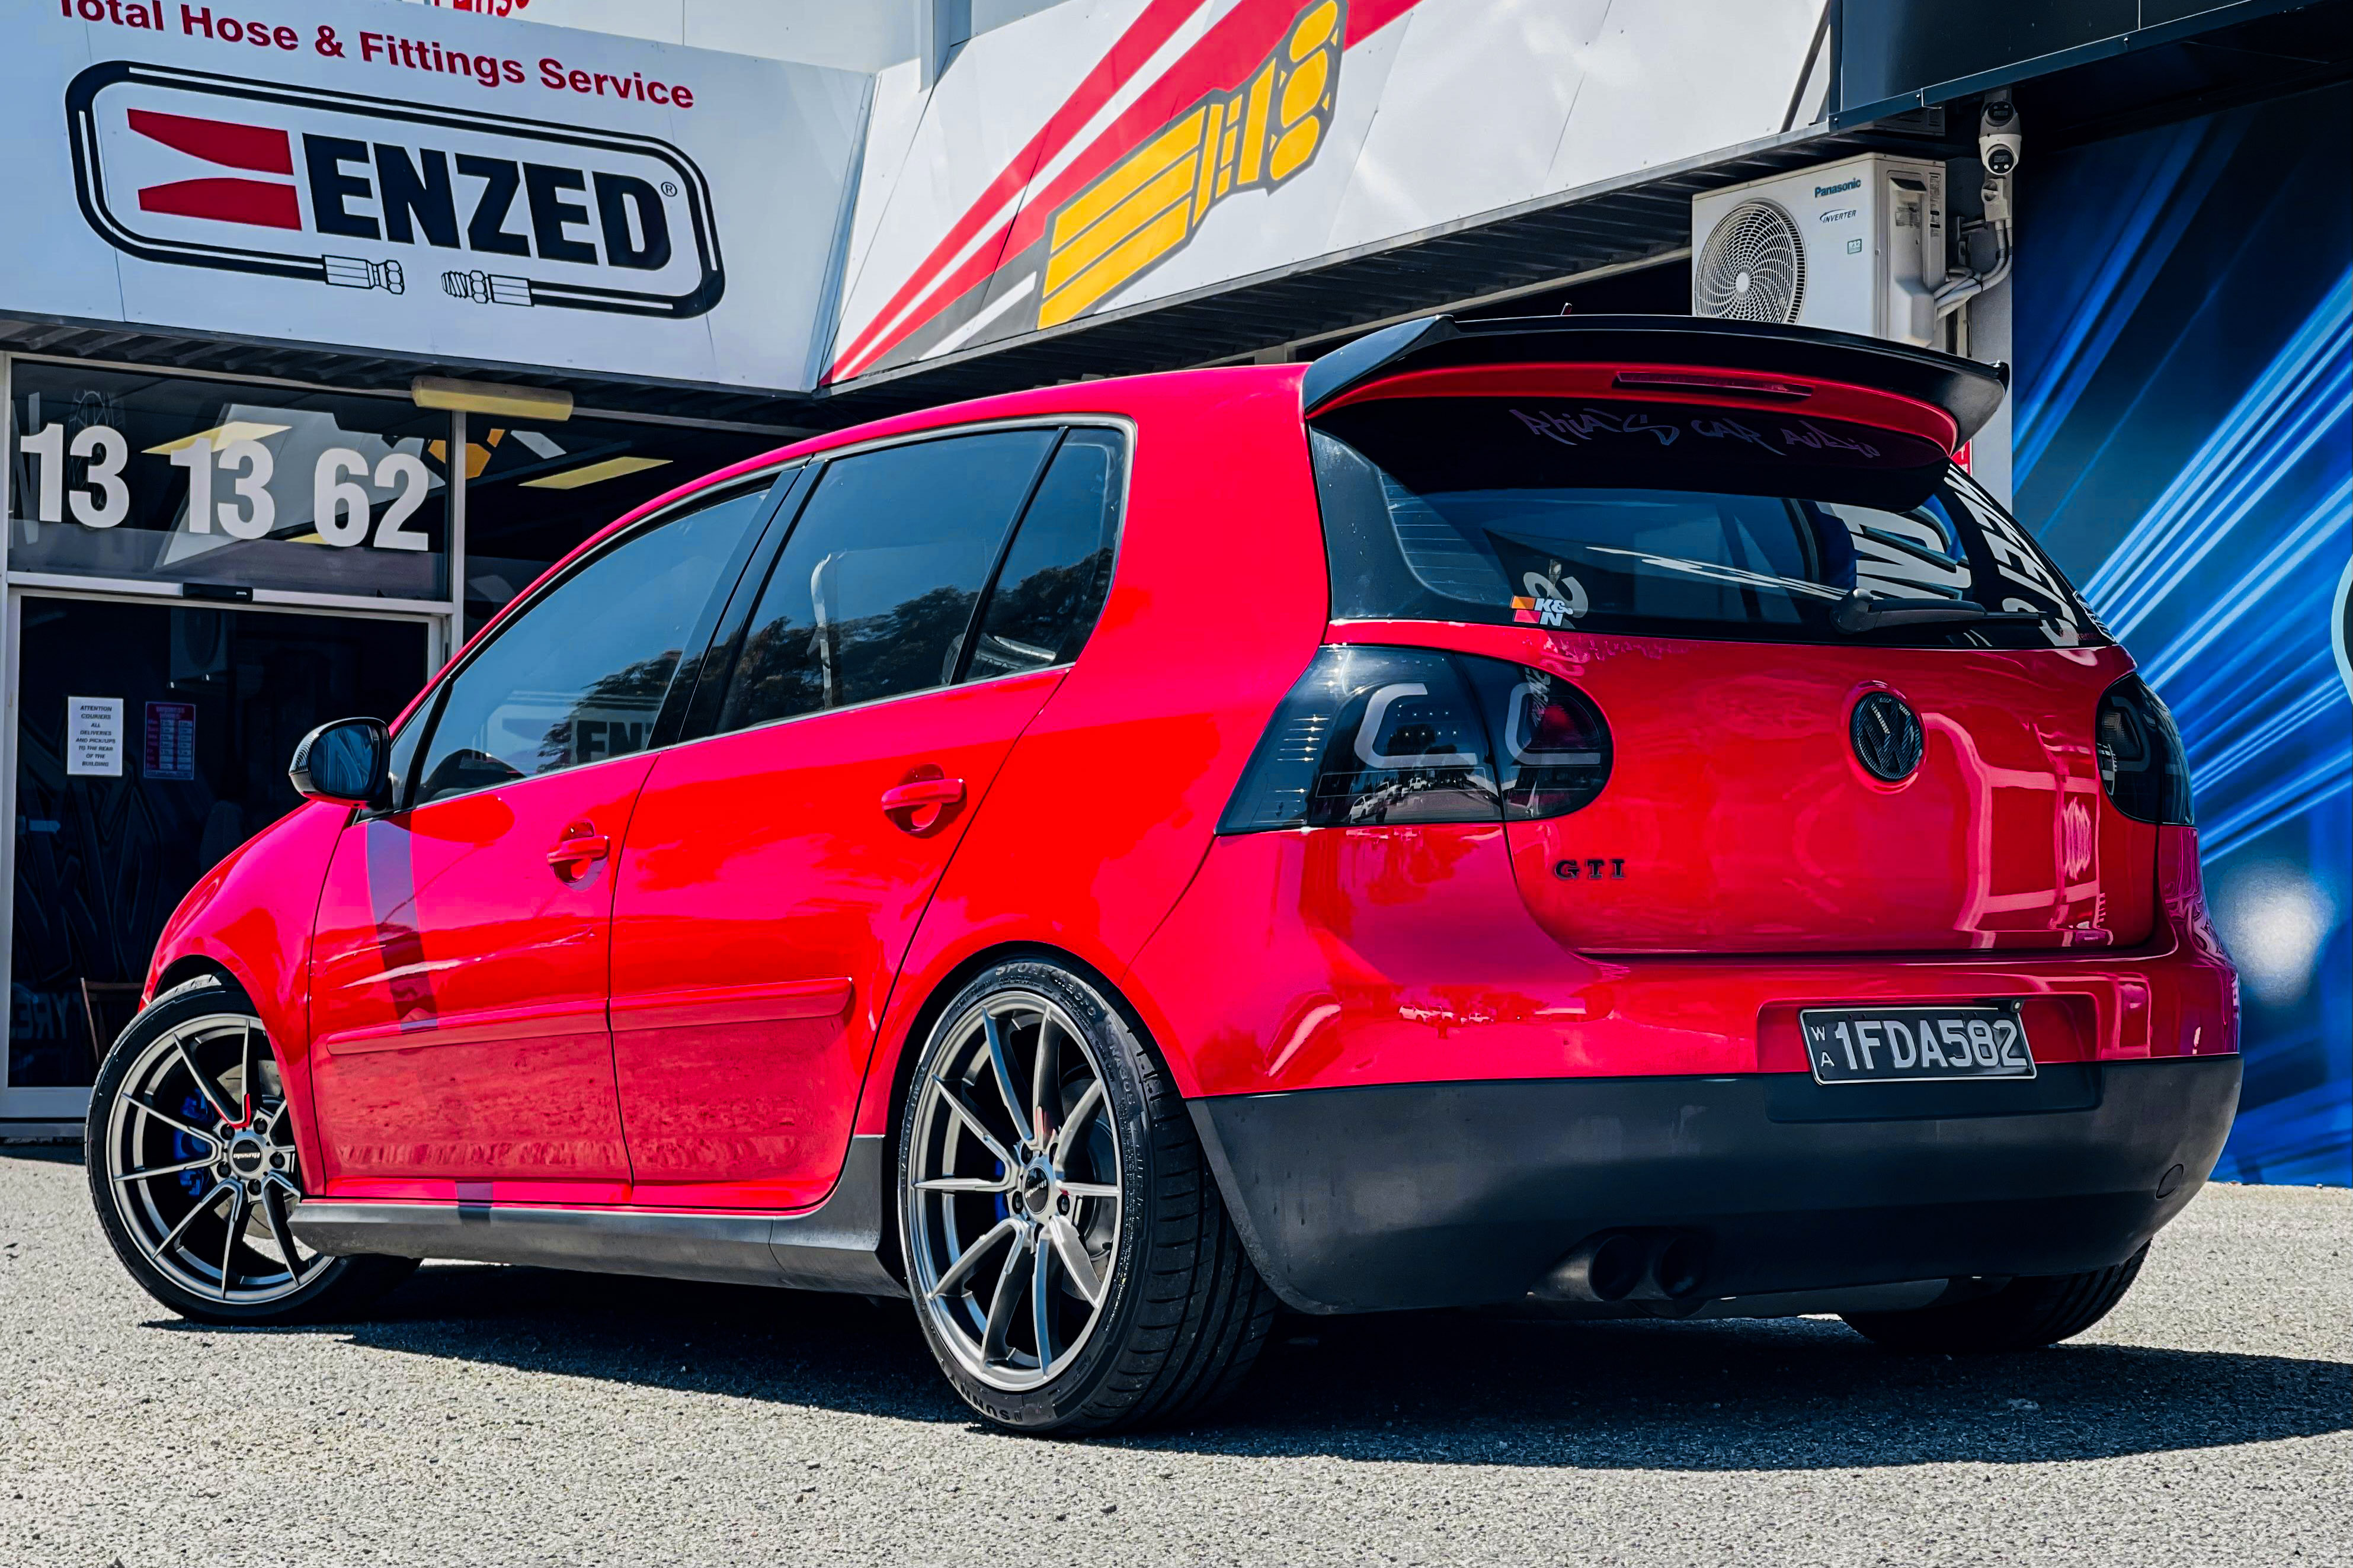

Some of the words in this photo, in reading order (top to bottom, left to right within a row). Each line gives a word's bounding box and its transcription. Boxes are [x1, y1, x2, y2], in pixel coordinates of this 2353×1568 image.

[181, 4, 299, 50] Hose
[315, 25, 345, 58] &
[359, 31, 525, 88] Fittings
[539, 57, 694, 108] Service
[302, 132, 671, 271] ENZED
[1815, 177, 1861, 198] Panasonic
[1823, 210, 1856, 223] INVERTER
[20, 424, 129, 527] 13
[171, 438, 275, 538] 13
[314, 448, 428, 551] 62
[1555, 859, 1625, 880] GTI
[1835, 1019, 2028, 1070] 1FDA582
